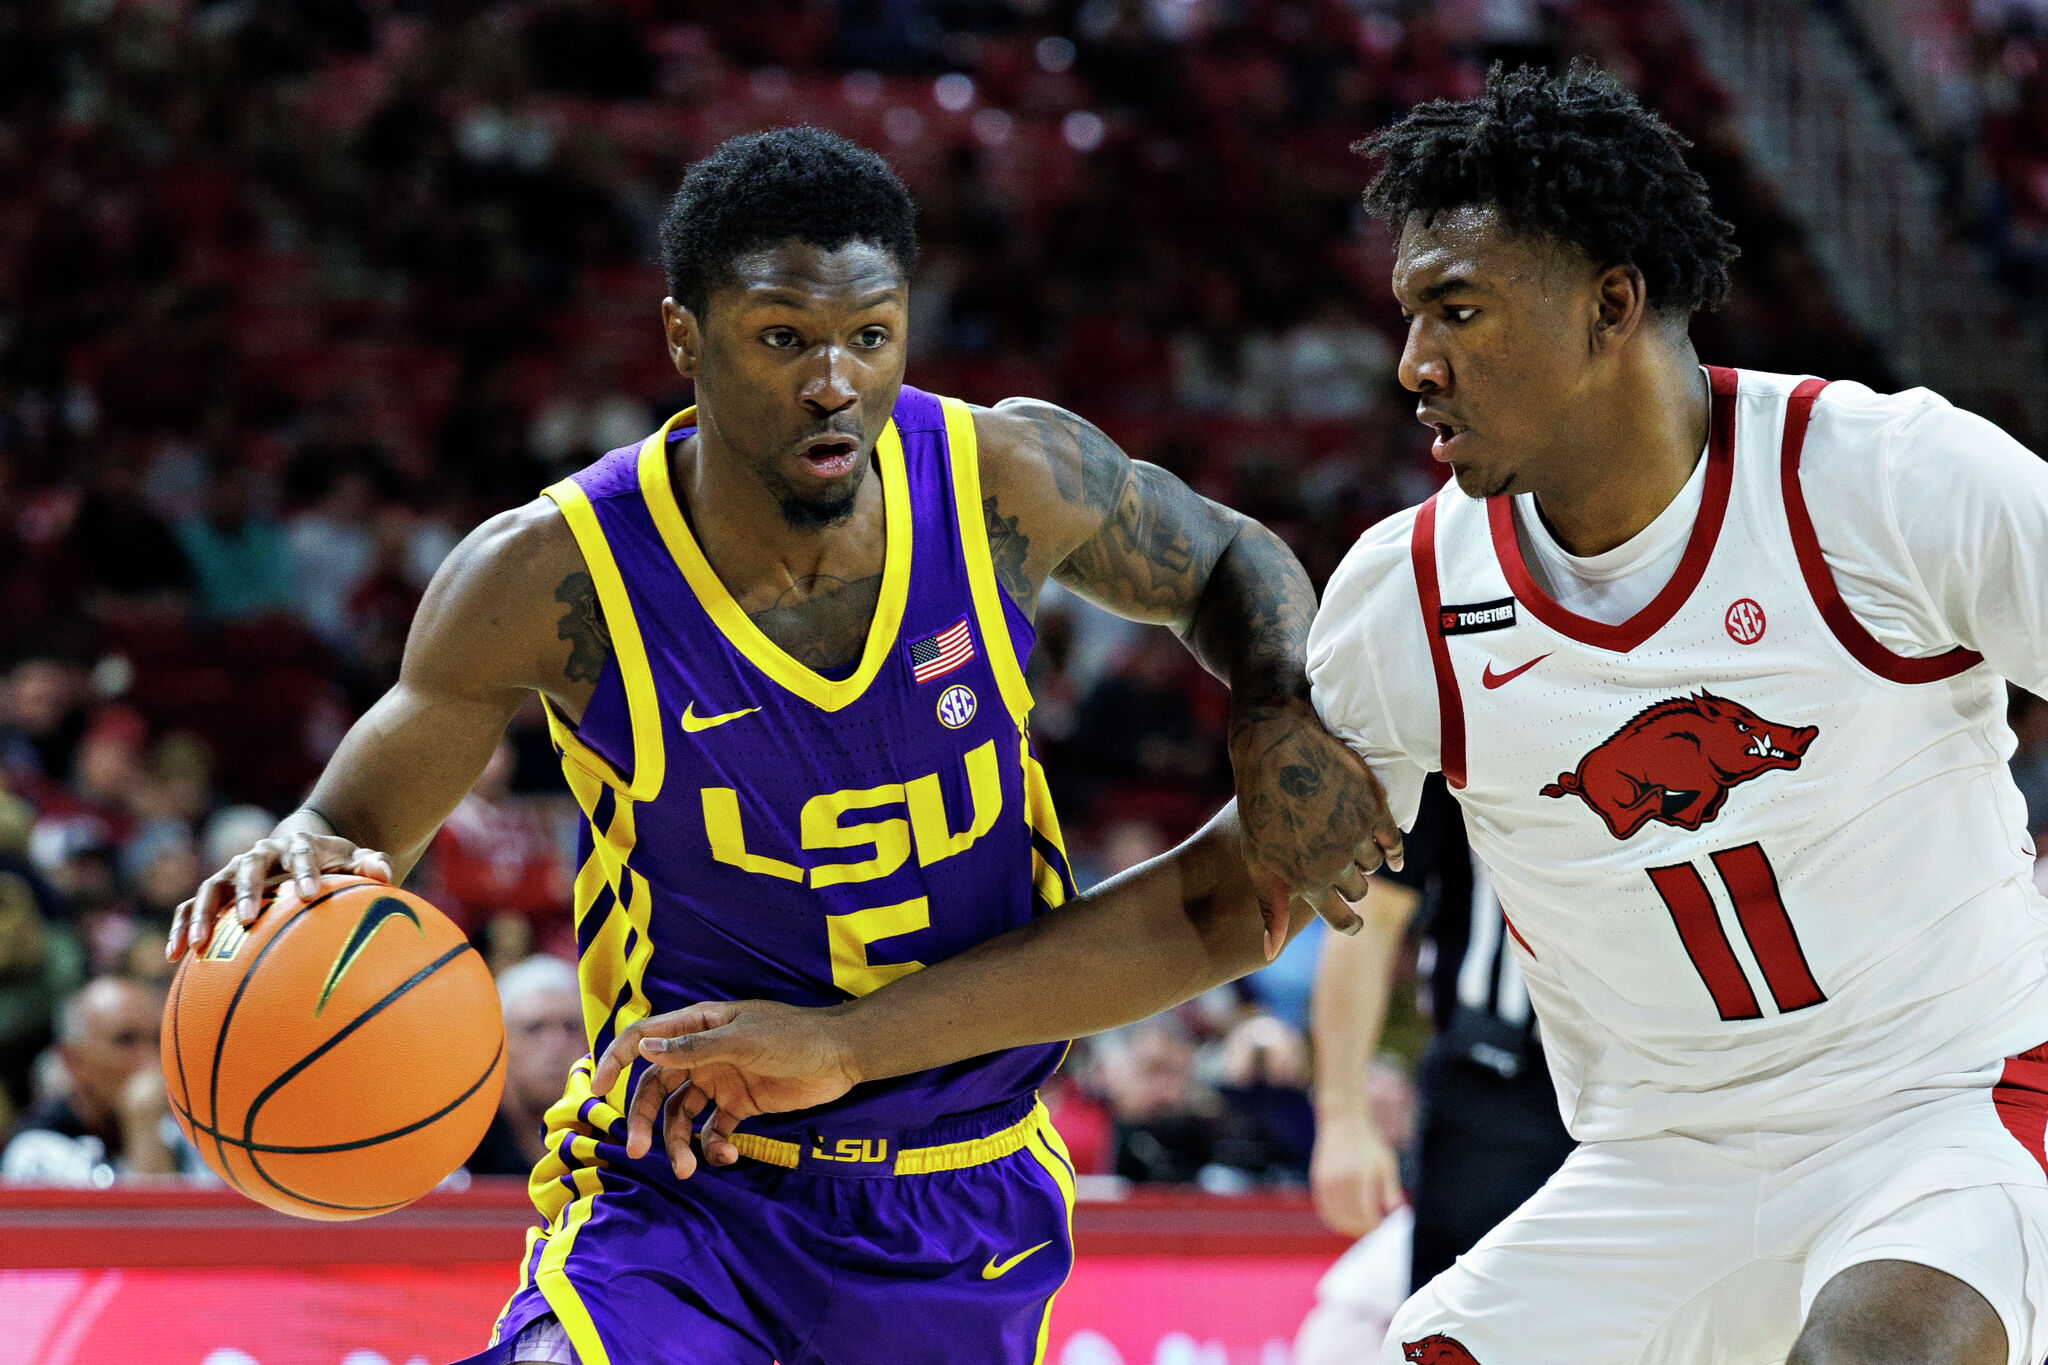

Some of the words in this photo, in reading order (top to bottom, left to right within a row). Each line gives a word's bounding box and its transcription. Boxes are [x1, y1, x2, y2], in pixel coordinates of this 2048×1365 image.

[1458, 605, 1514, 626] TOGETHER
[1728, 602, 1763, 641] SEC
[940, 688, 974, 726] SEC
[700, 739, 1003, 889] LSU
[1644, 840, 1829, 1021] 11
[811, 1135, 888, 1163] LSU
